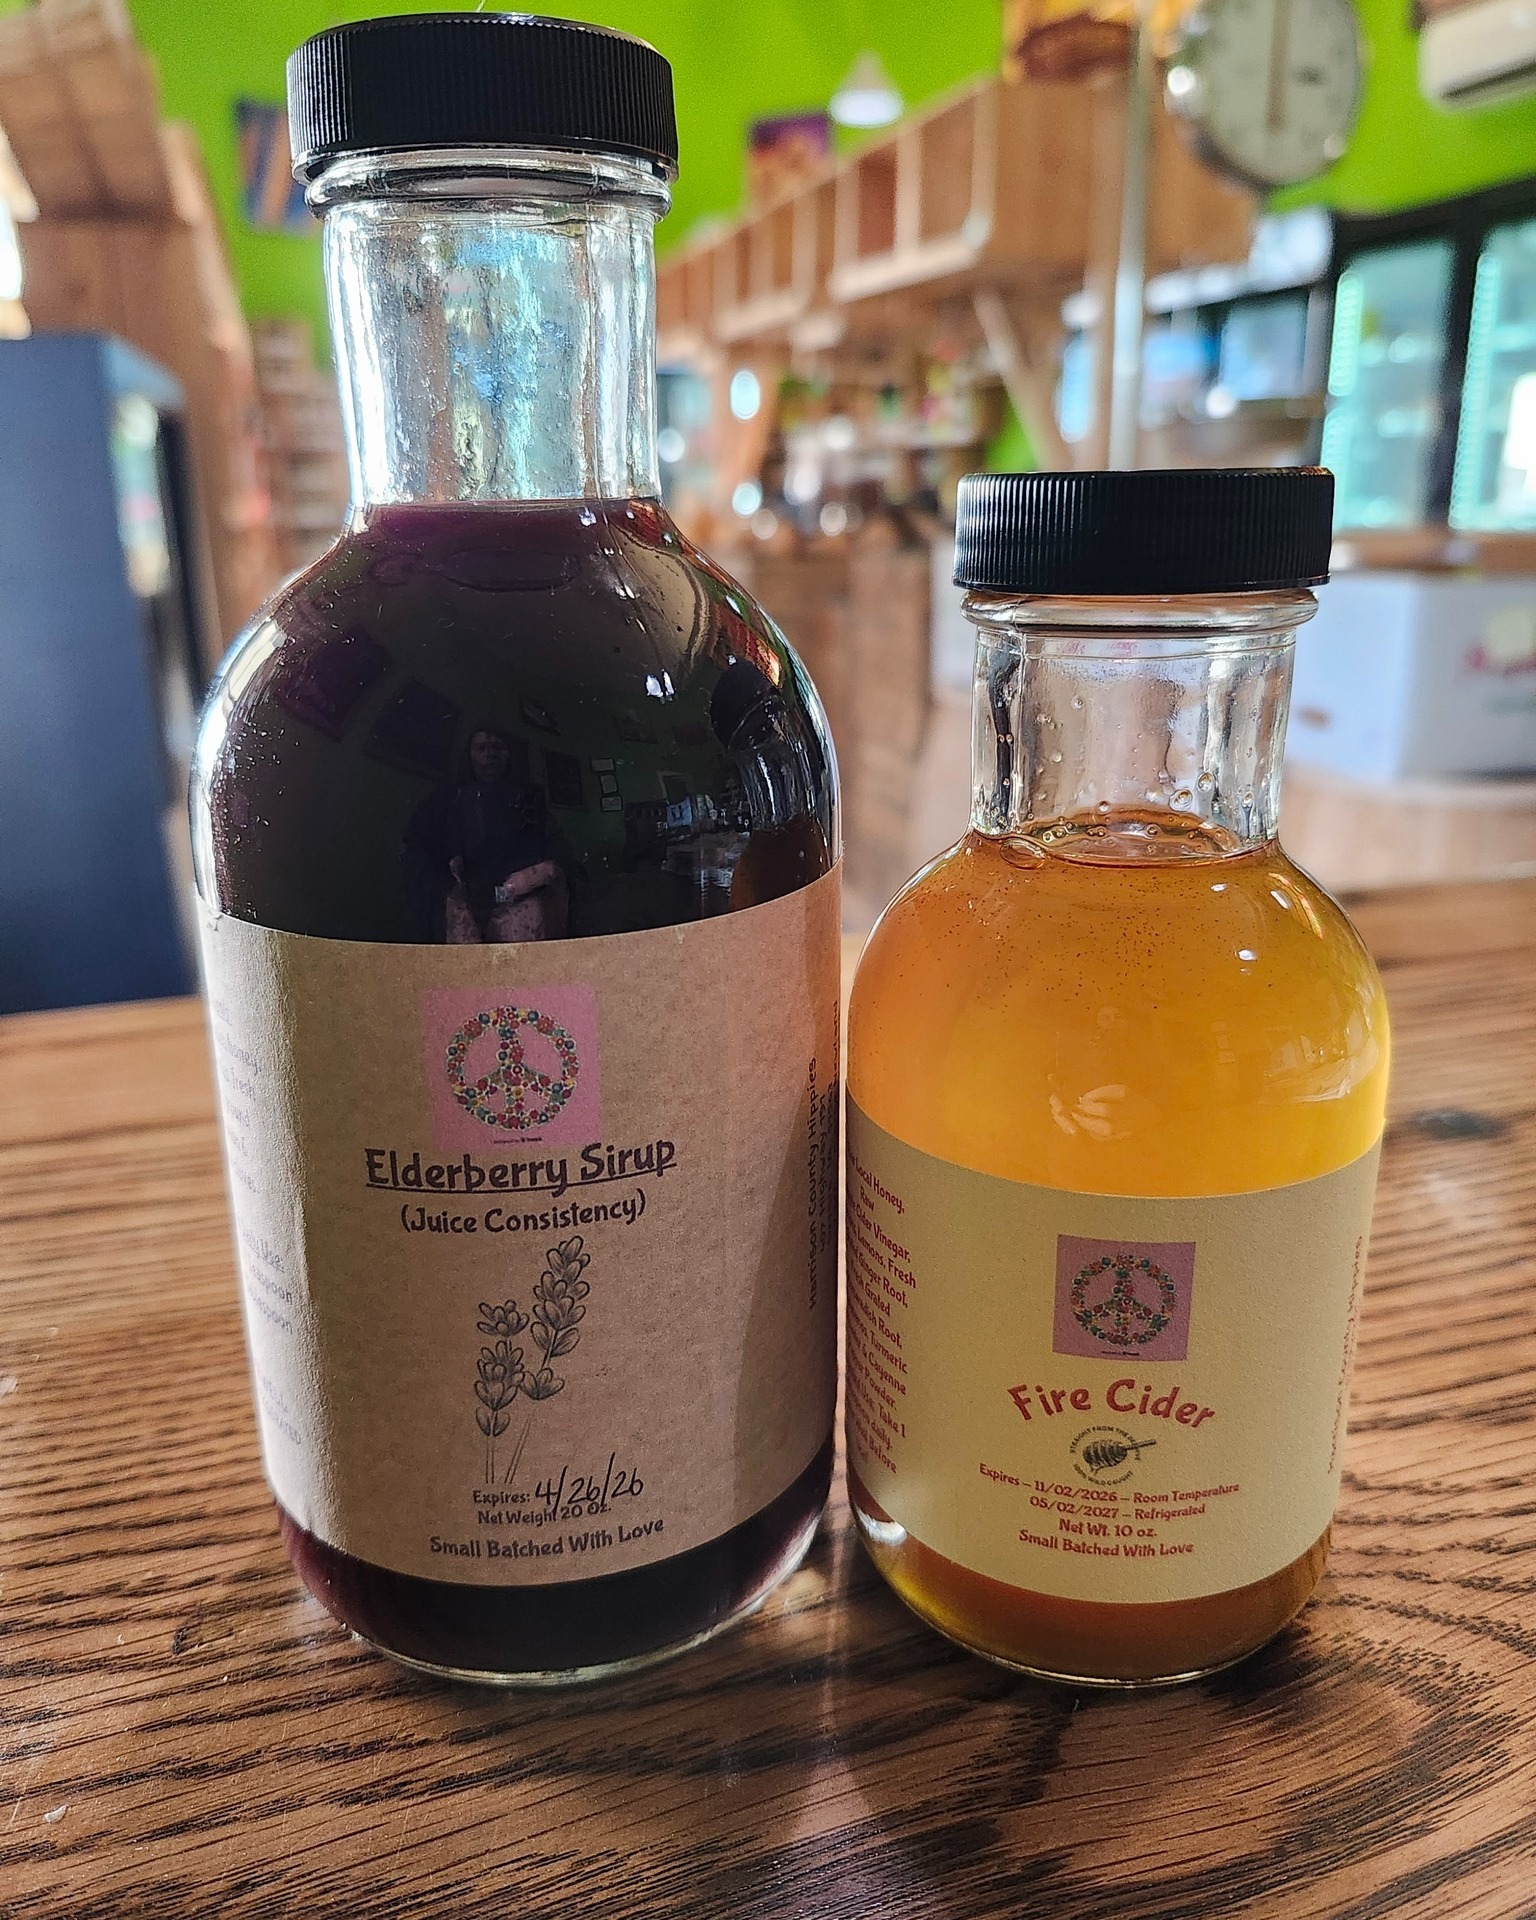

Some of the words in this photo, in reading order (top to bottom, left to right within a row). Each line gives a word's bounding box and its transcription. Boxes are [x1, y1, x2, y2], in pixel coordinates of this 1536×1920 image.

[807, 1057, 818, 1139] Hippies
[364, 1147, 569, 1198] Elderberry
[580, 1139, 676, 1176] Sirup
[808, 1142, 819, 1216] County
[855, 1157, 873, 1188] Local
[873, 1176, 905, 1215] Honey,
[401, 1204, 477, 1233] (Juice
[484, 1187, 647, 1233] Consistency)
[873, 1222, 911, 1263] Vinegar,
[888, 1257, 916, 1288] Fresh
[865, 1282, 890, 1317] Grated
[869, 1330, 908, 1374] Turmeric
[869, 1351, 906, 1396] Cayenne
[878, 1402, 899, 1434] Take
[1007, 1384, 1092, 1421] Fire
[1105, 1378, 1216, 1428] Cider
[869, 1435, 897, 1474] Before
[473, 1489, 531, 1508] Expires:
[535, 1452, 644, 1518] 4/26/26
[979, 1462, 1020, 1487] Expires
[1034, 1480, 1118, 1503] 11/02/2026
[1133, 1492, 1169, 1504] Room
[1171, 1483, 1240, 1503] Temperature
[478, 1510, 504, 1525] Net
[506, 1507, 557, 1528] Weight
[560, 1503, 583, 1520] 20
[1030, 1496, 1119, 1519] 05/02/2027
[1134, 1504, 1206, 1522] Refrigerated
[1059, 1518, 1084, 1536] Net
[1086, 1521, 1110, 1537] Wt.
[1114, 1524, 1133, 1537] 10
[1136, 1527, 1157, 1538] oz.
[430, 1535, 482, 1559] Small
[487, 1536, 564, 1559] Batched
[569, 1530, 612, 1552] With
[618, 1518, 664, 1543] Love
[1018, 1529, 1058, 1551] Small
[1062, 1538, 1120, 1557] Batched
[1123, 1544, 1155, 1558] With
[1159, 1542, 1194, 1555] Love
